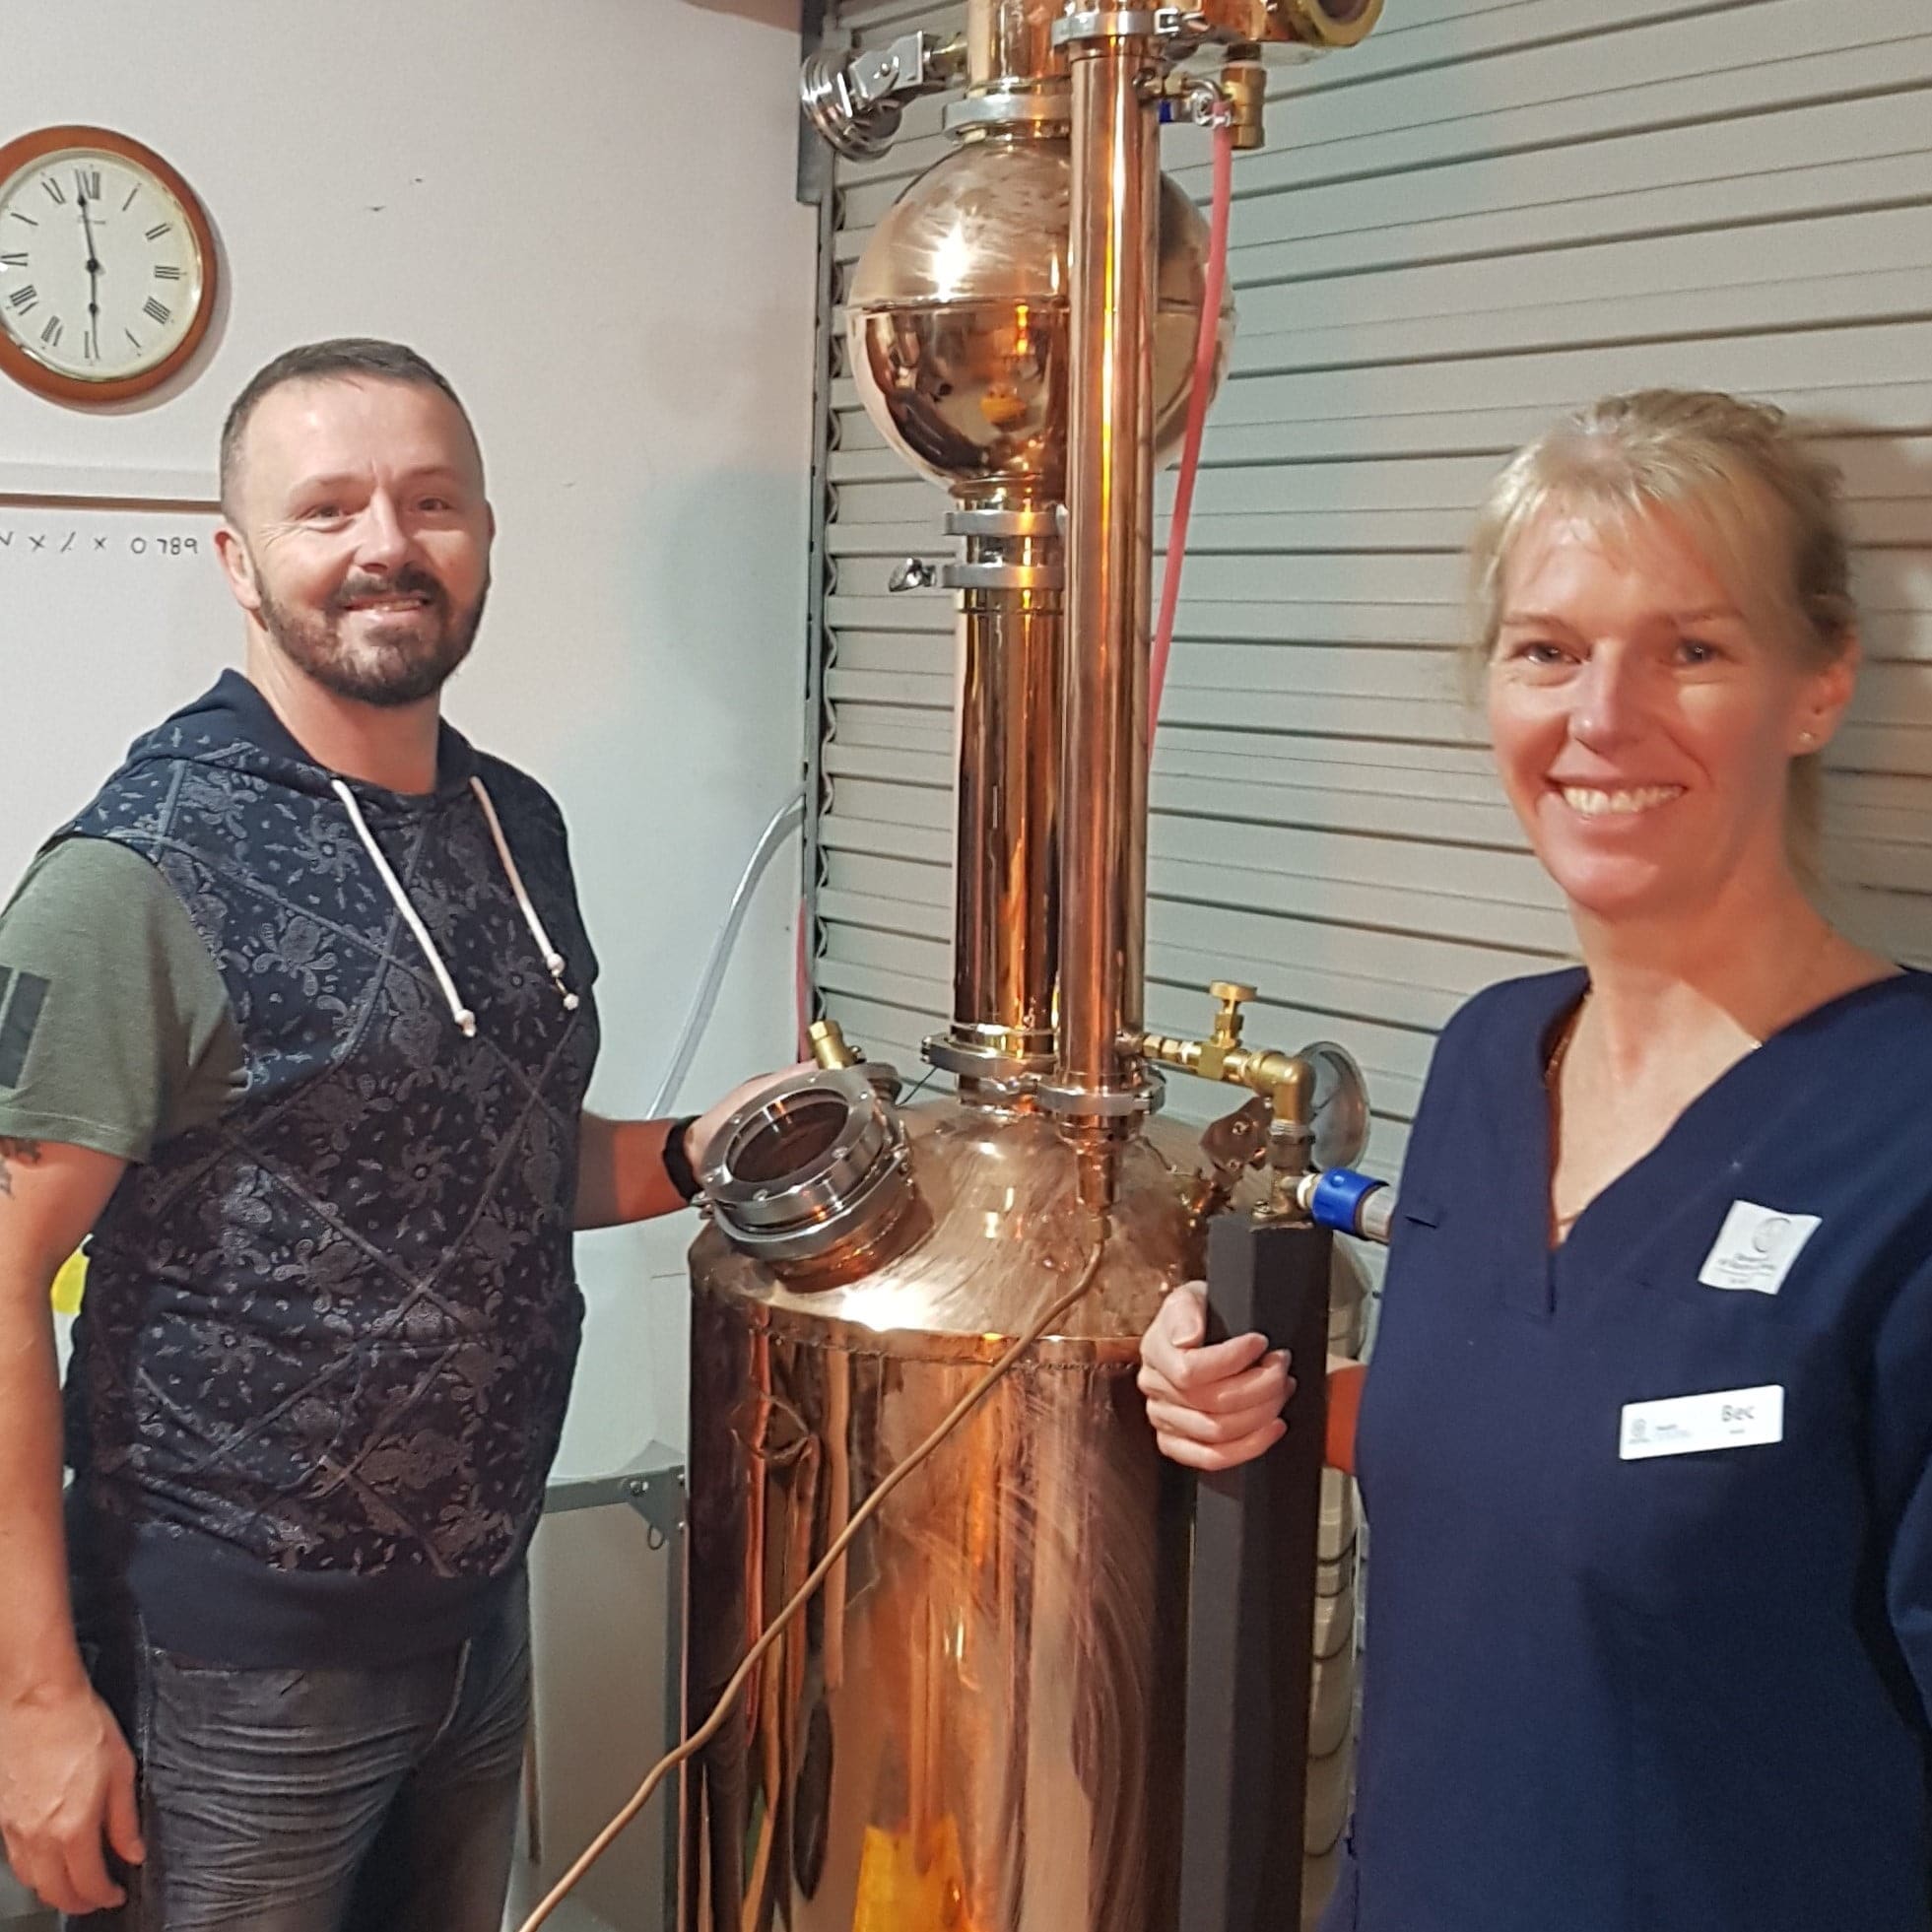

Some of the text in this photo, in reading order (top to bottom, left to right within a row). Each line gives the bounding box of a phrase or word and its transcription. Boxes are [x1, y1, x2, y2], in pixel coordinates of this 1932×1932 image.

[144, 222, 171, 241] II
[154, 264, 180, 281] III
[1722, 1404, 1755, 1422] Bec
